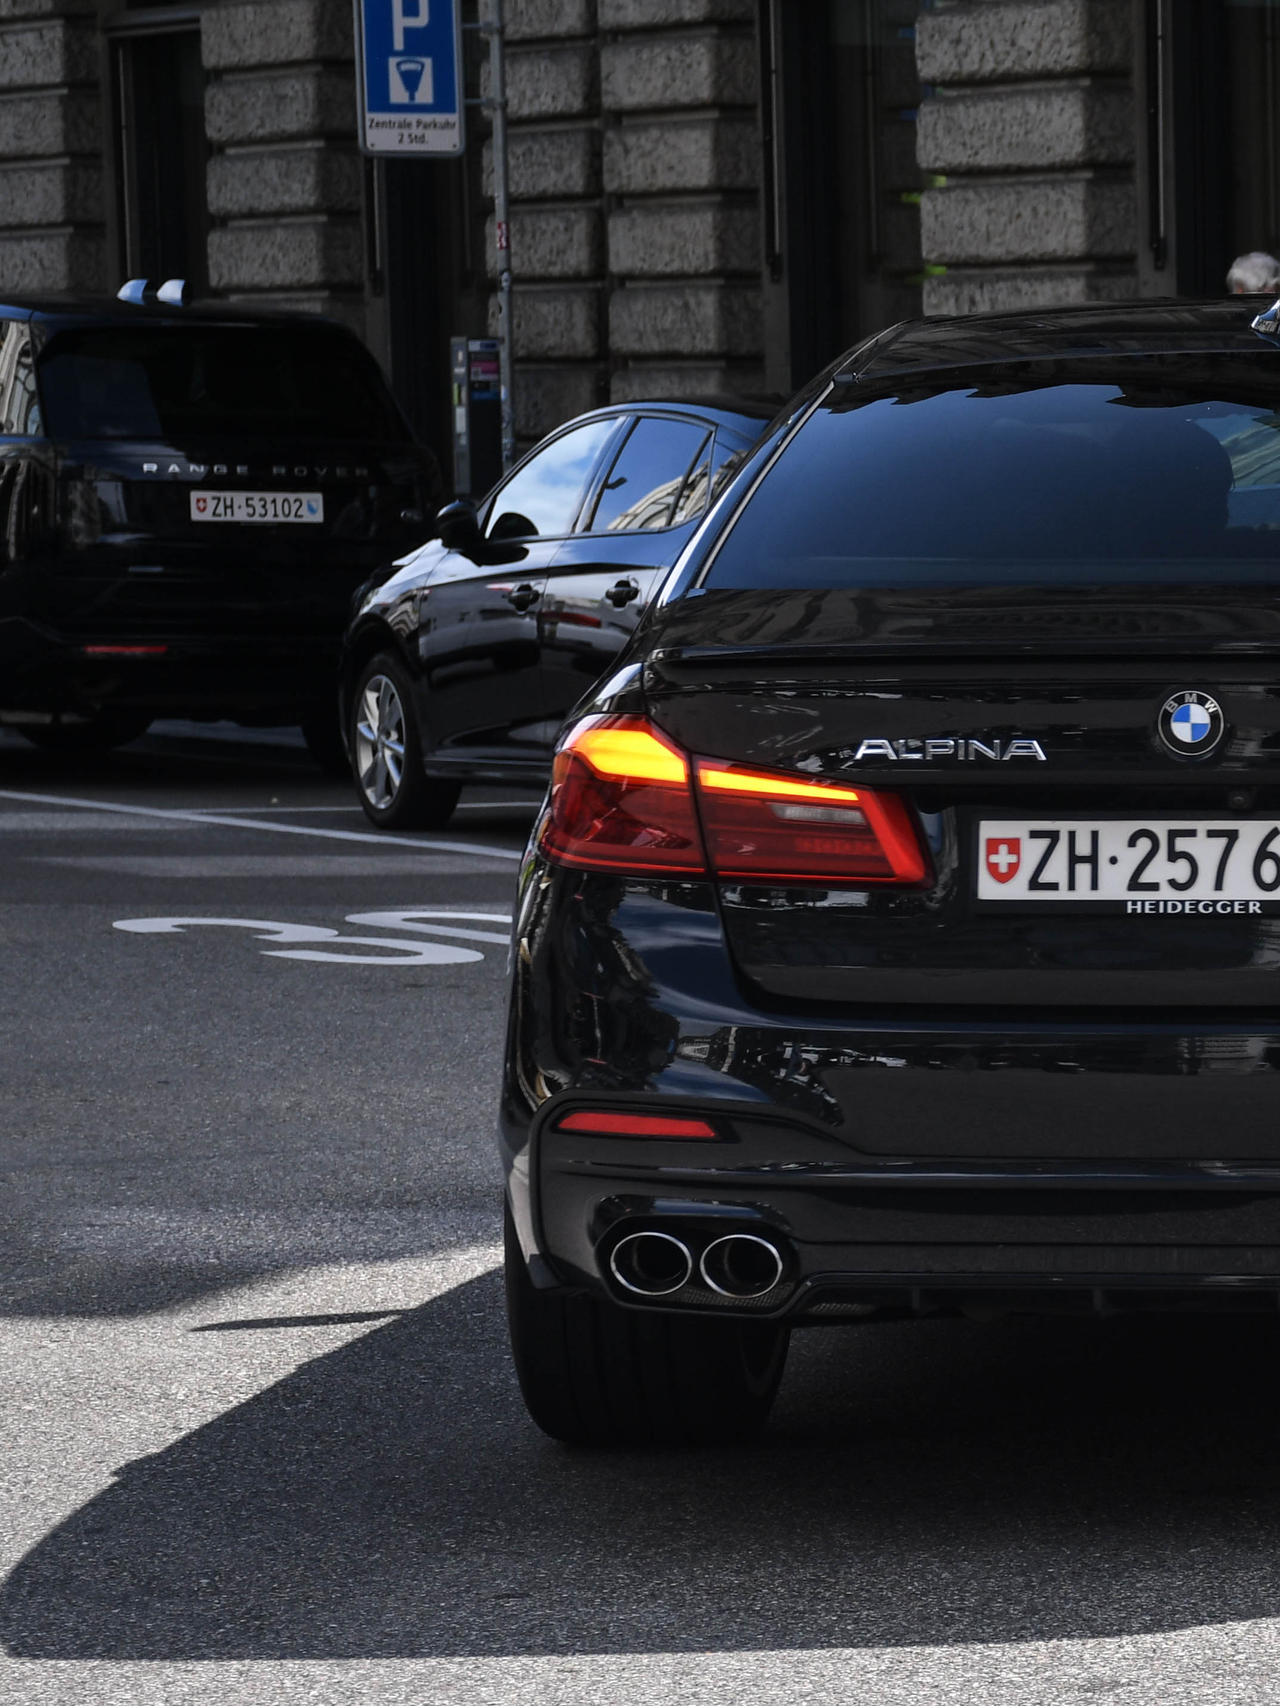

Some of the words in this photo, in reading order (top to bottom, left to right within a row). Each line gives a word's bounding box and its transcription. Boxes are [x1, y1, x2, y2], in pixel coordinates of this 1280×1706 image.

[392, 0, 429, 51] P
[368, 118, 413, 130] Zentrale
[416, 118, 456, 131] Parkuhr
[398, 133, 404, 144] 2
[408, 133, 428, 144] Std.
[143, 463, 248, 477] RANGE
[272, 466, 368, 478] ROVER
[1165, 693, 1218, 713] BMW
[854, 739, 1047, 761] ALPINA
[1126, 901, 1263, 915] HEIDEGGER
